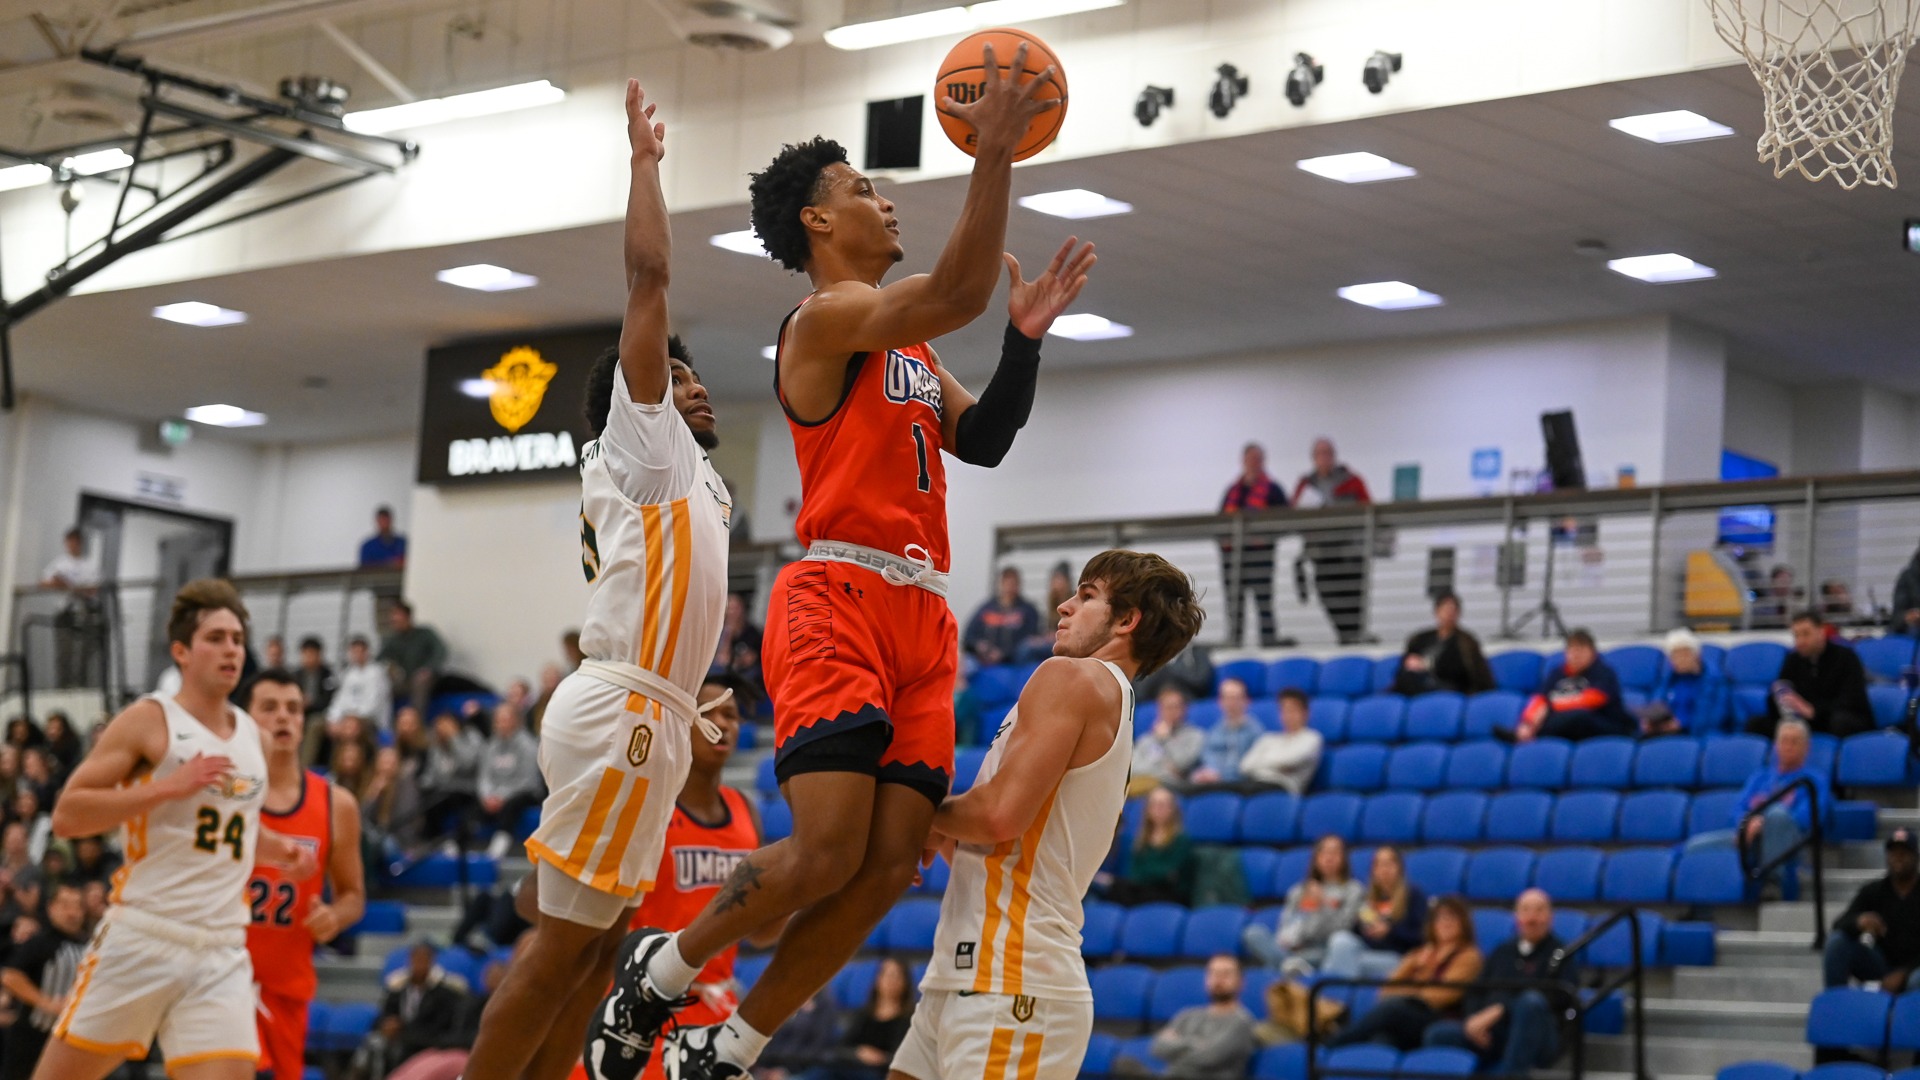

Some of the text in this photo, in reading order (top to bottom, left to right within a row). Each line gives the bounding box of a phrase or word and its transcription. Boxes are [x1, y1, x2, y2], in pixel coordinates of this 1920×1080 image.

[946, 81, 987, 105] Wil
[448, 431, 577, 476] BRAVERA
[912, 422, 930, 493] 1
[195, 806, 245, 862] 24
[249, 879, 296, 927] 22
